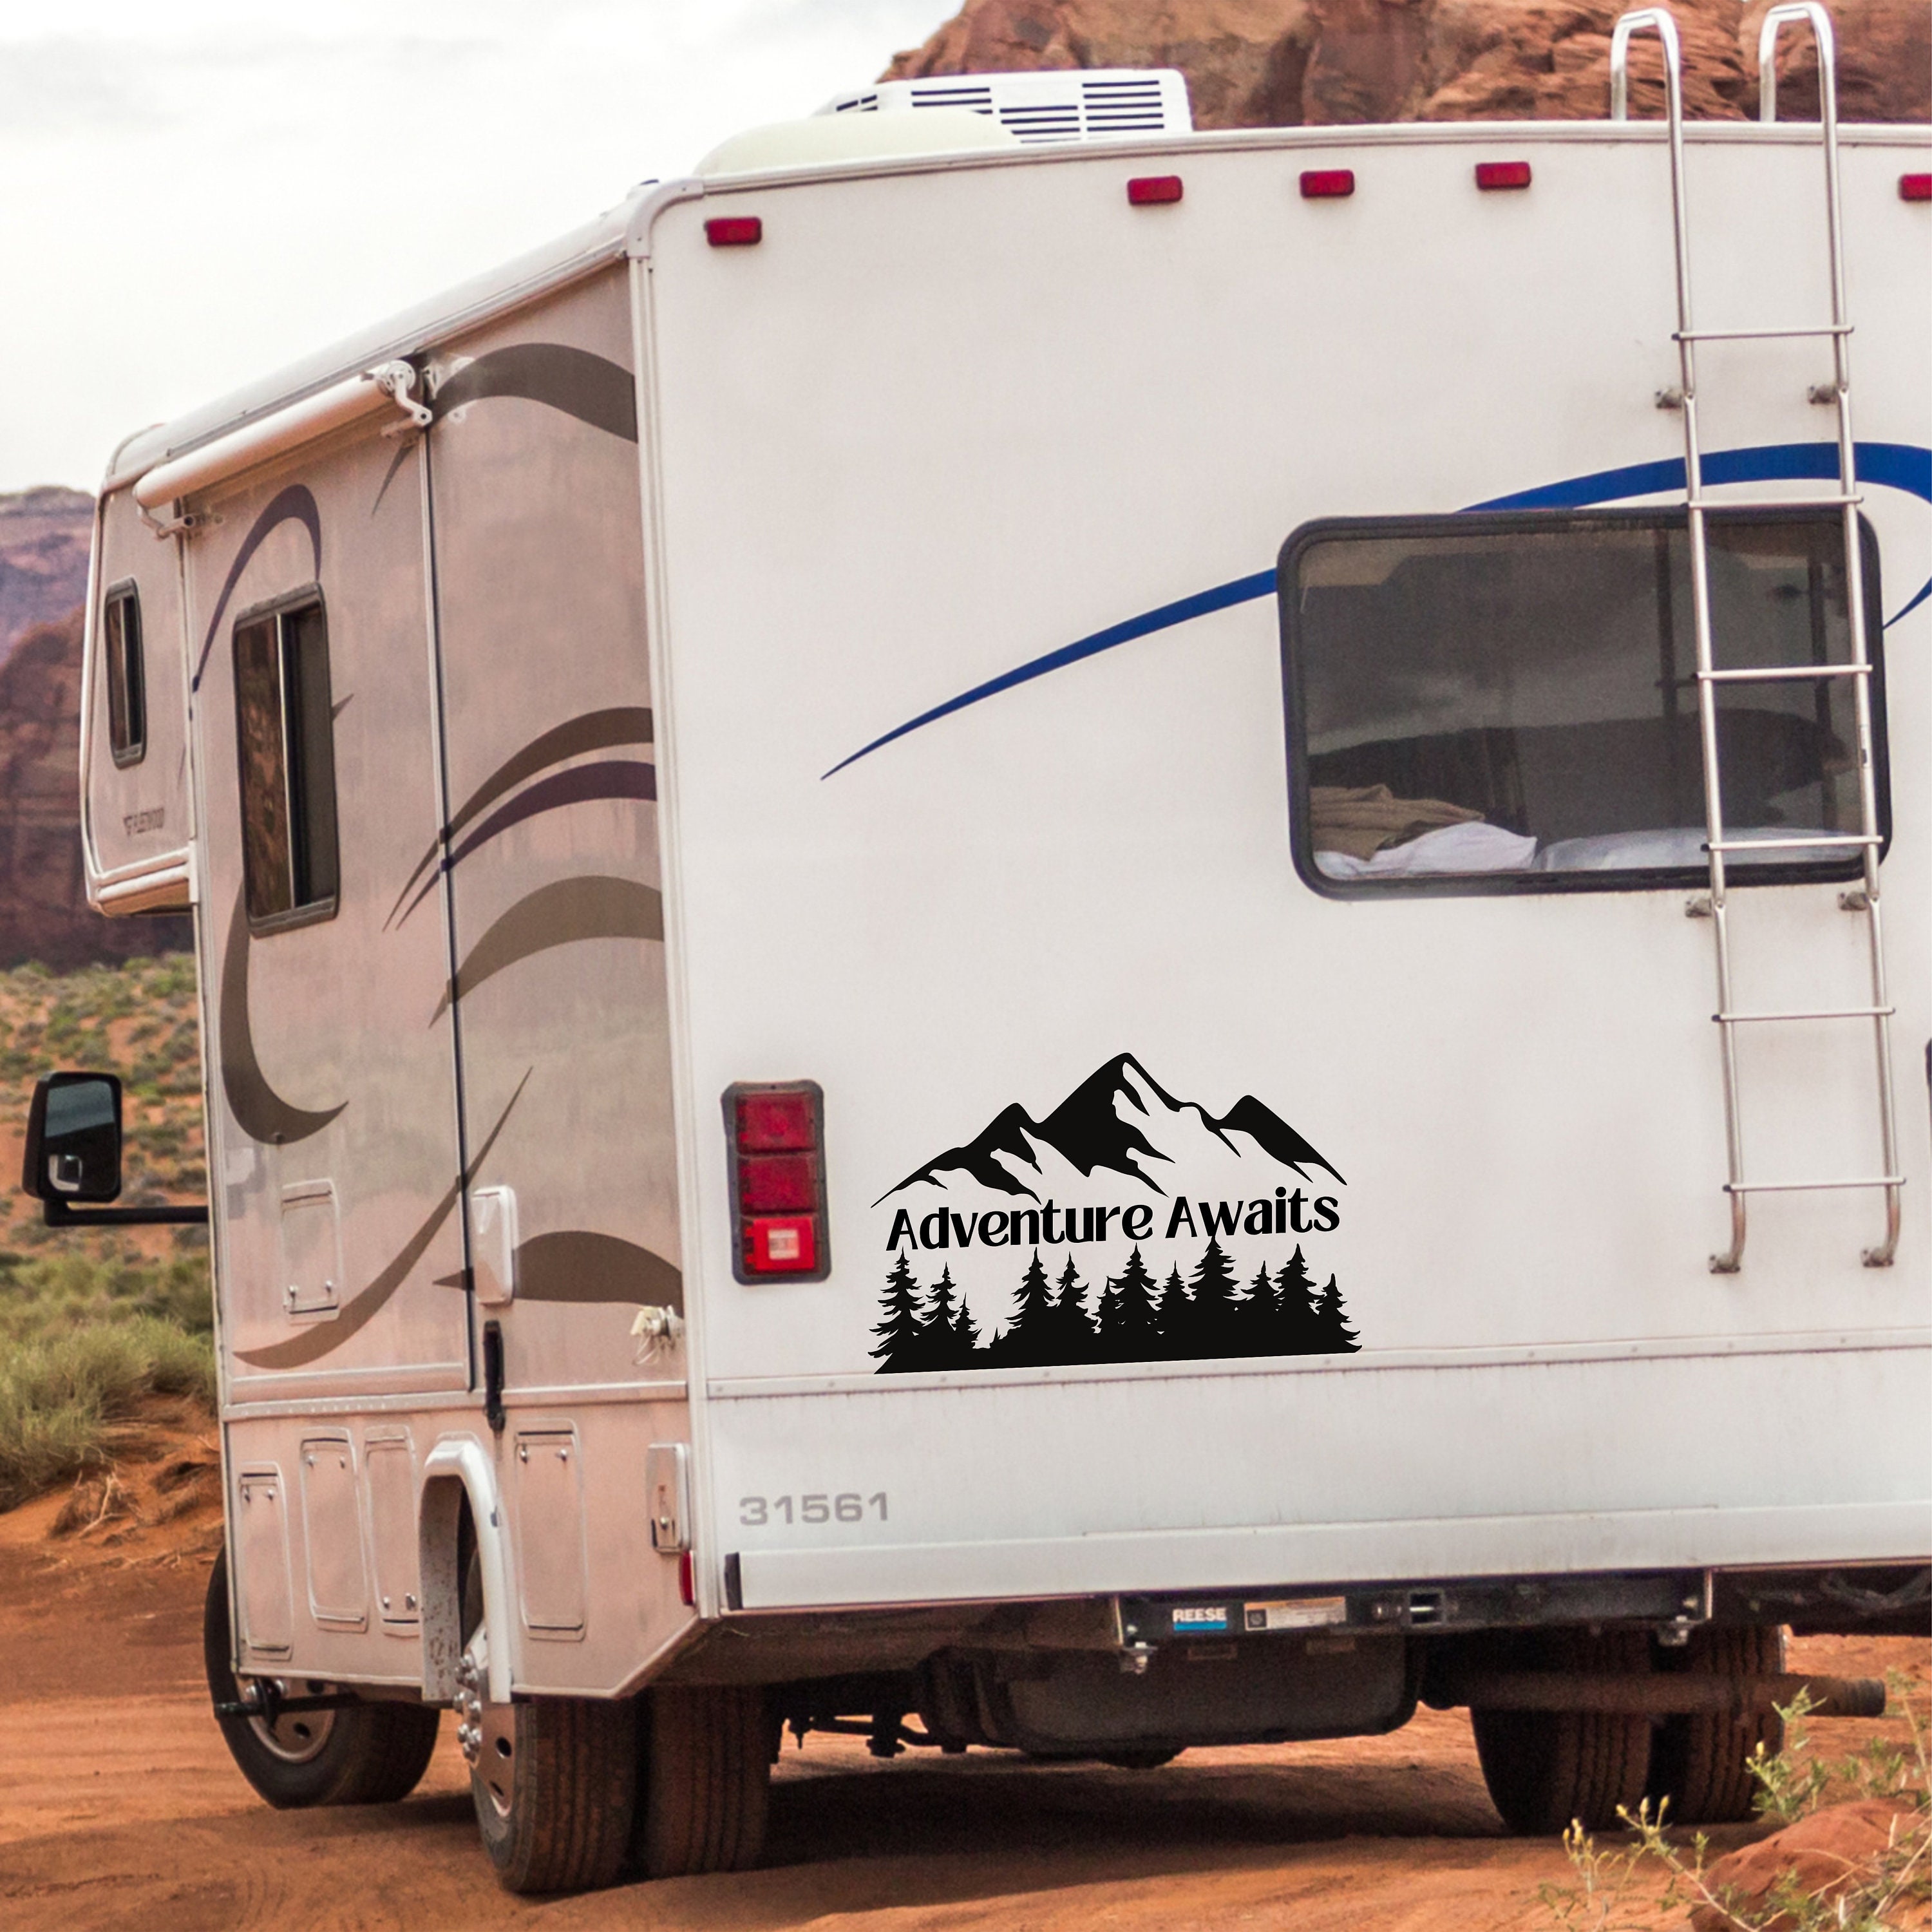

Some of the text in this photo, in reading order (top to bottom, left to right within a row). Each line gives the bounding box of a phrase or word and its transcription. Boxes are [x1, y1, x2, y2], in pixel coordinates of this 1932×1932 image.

[886, 1187, 1340, 1251] Adventure Awaits
[739, 1492, 888, 1526] 31561
[1173, 1607, 1226, 1622] REESE
